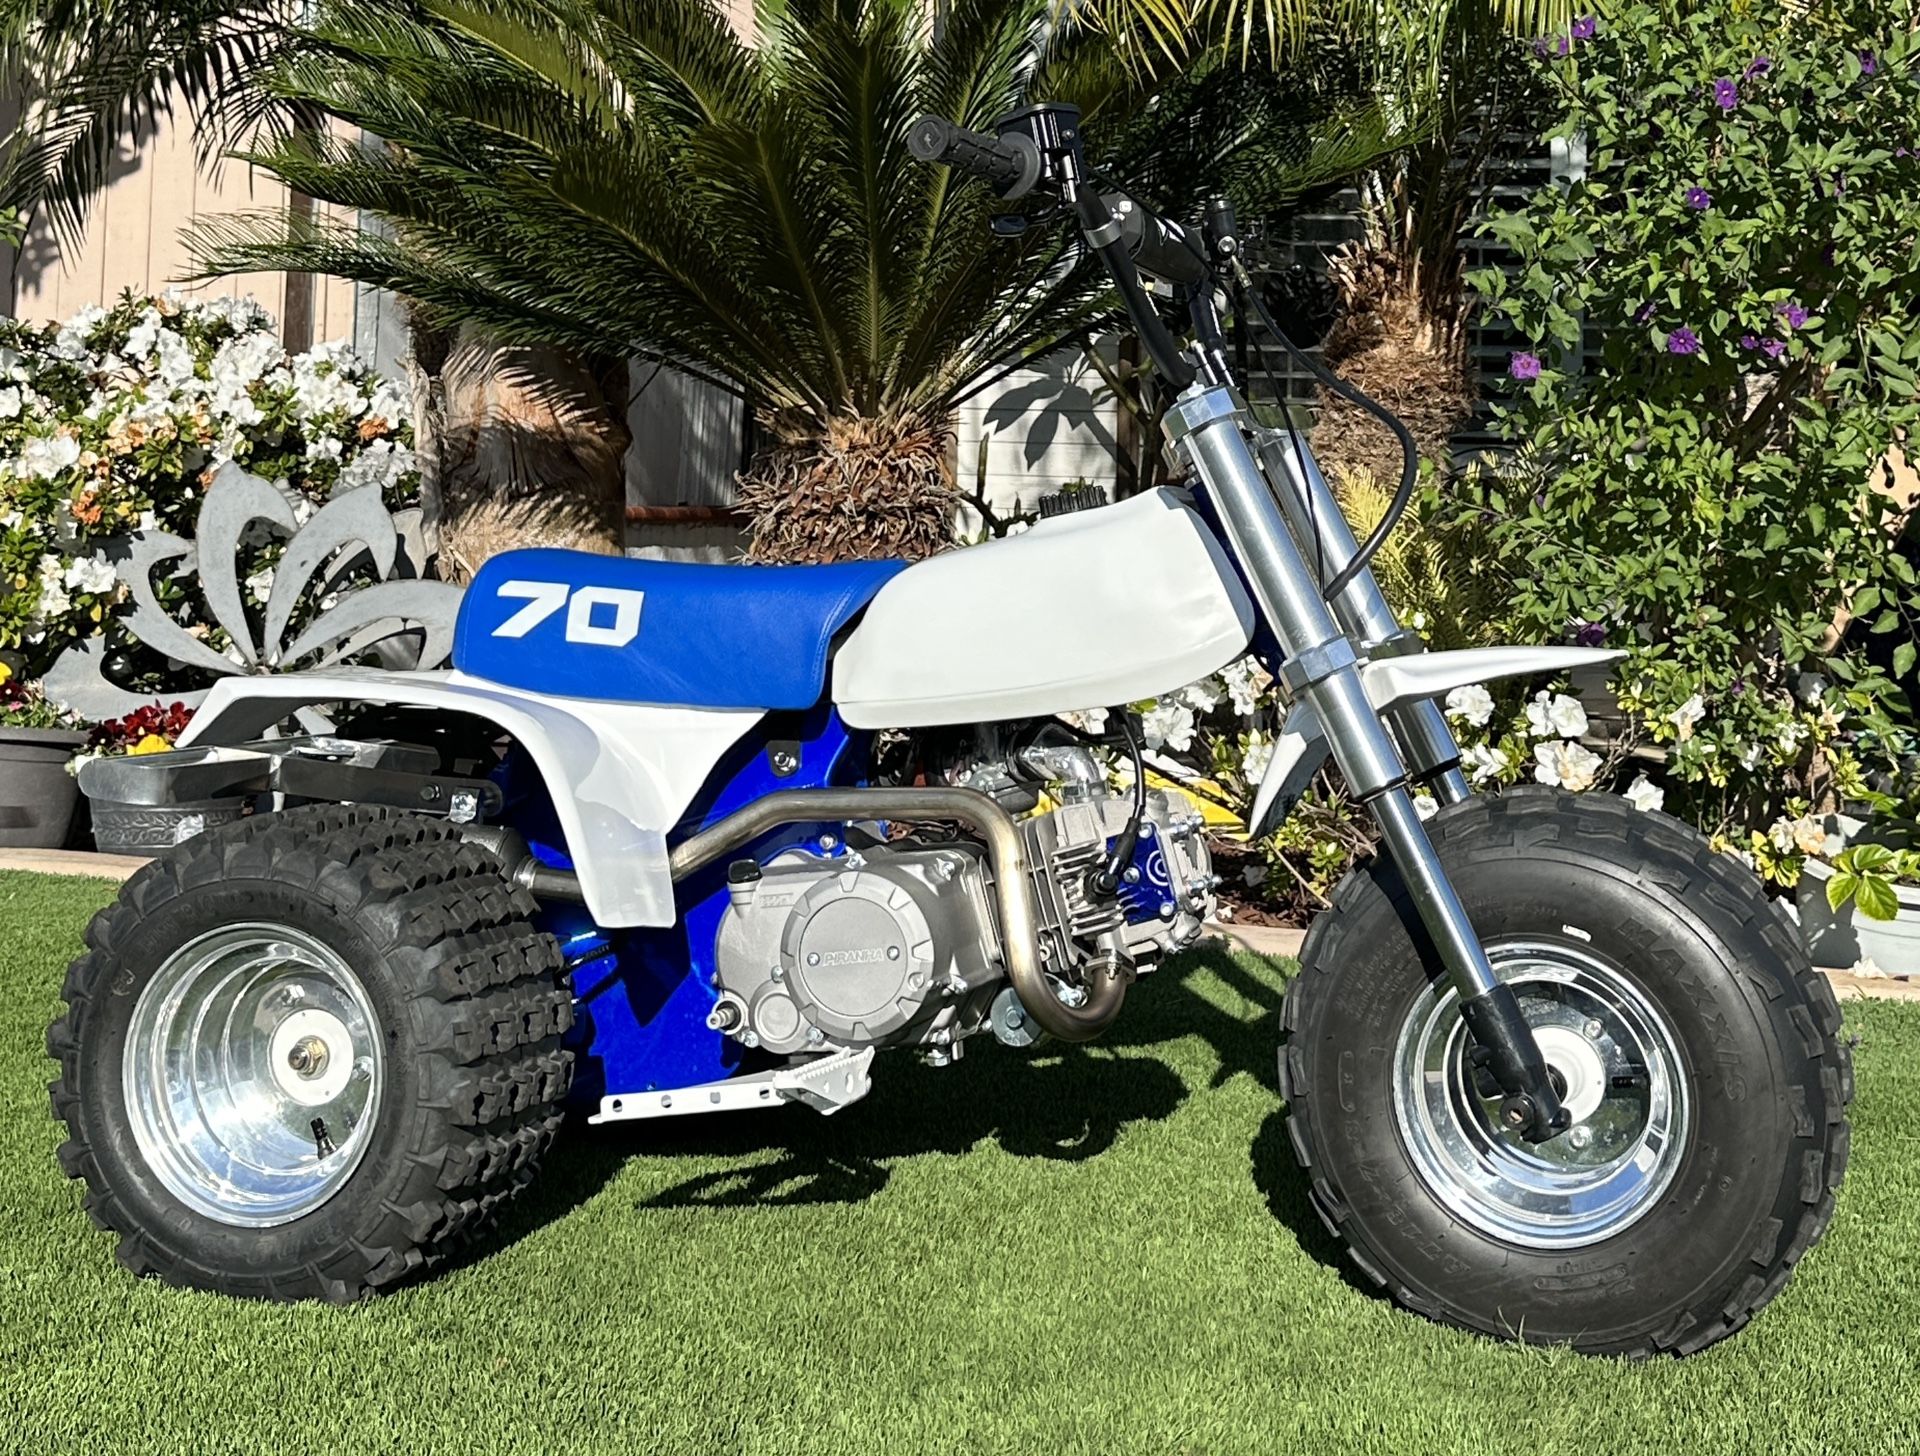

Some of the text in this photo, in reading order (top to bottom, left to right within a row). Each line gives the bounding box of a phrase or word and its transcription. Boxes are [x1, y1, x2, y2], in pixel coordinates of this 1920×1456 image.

[491, 580, 645, 647] 70
[822, 947, 885, 967] PIRANHA
[1617, 917, 1748, 1102] MAXXIS
